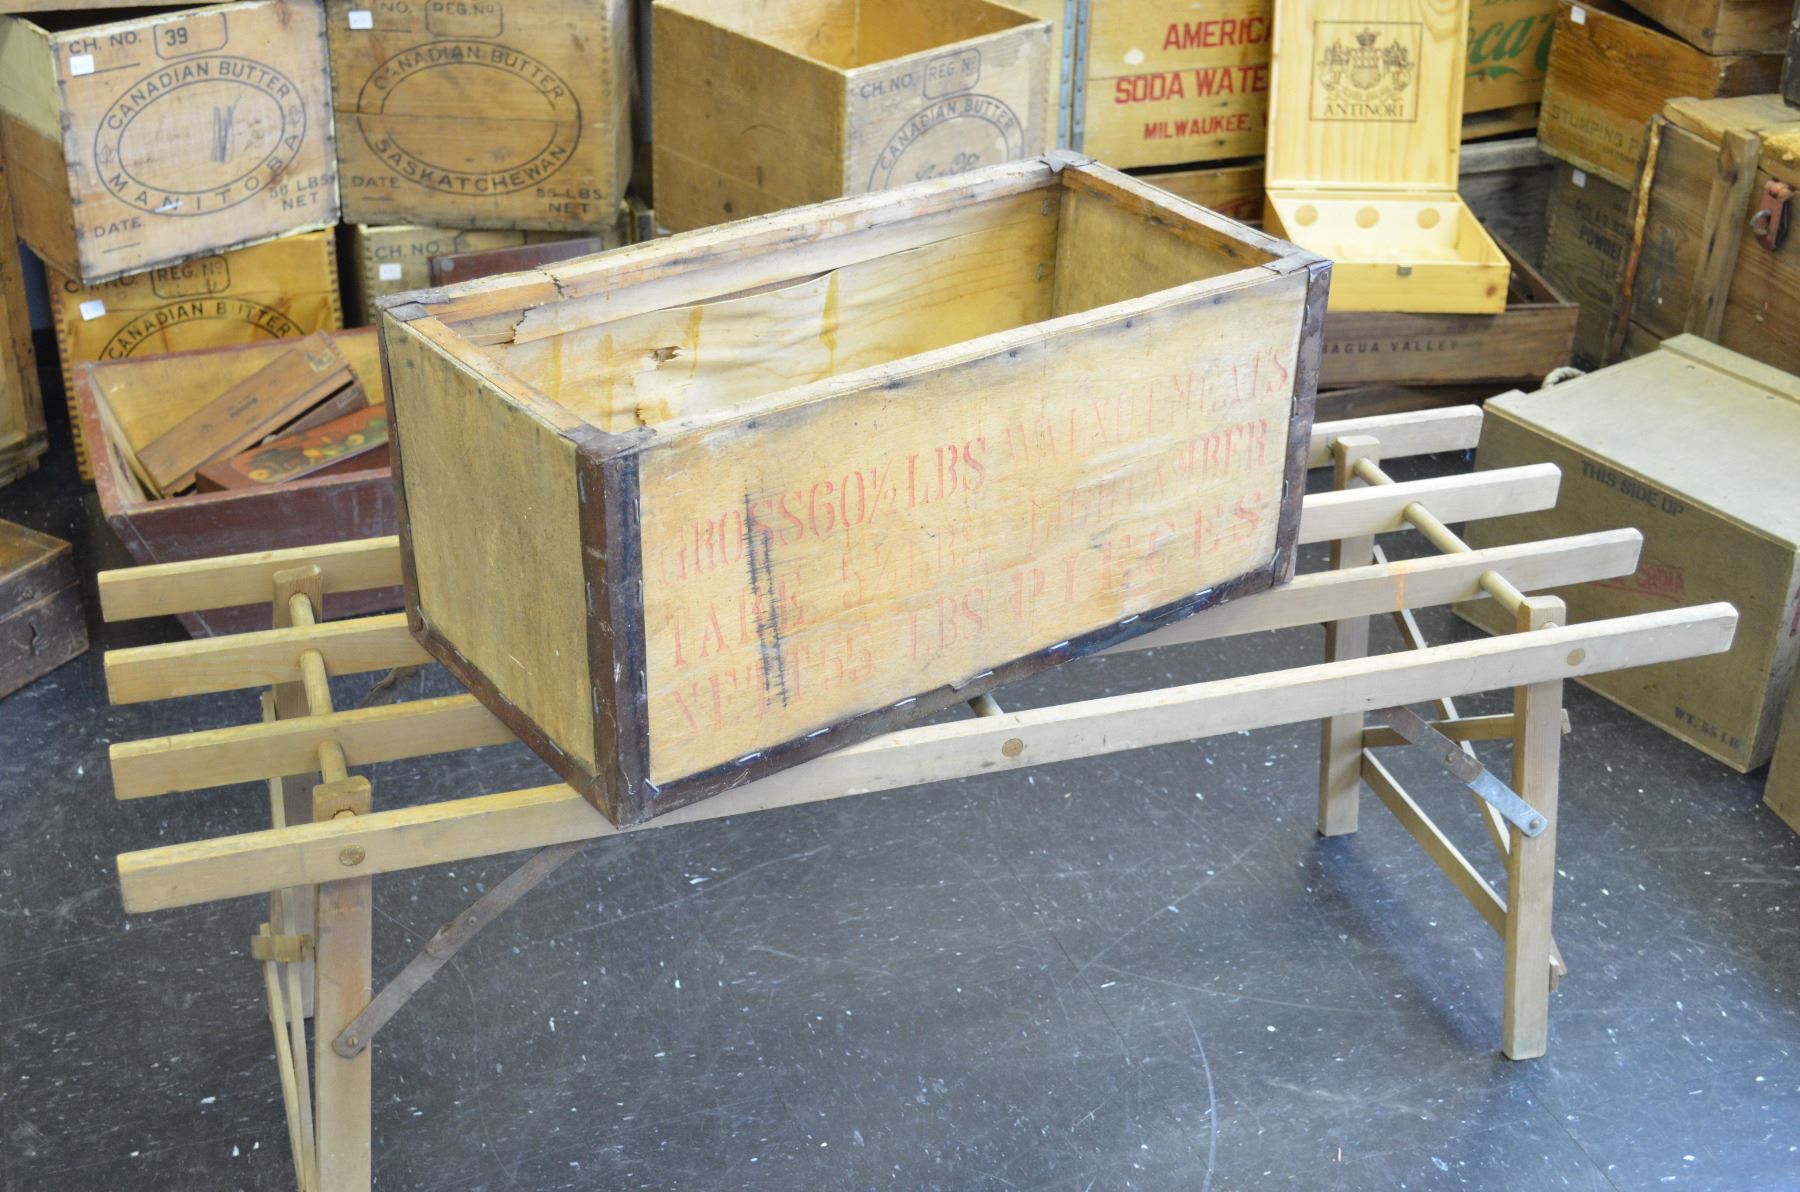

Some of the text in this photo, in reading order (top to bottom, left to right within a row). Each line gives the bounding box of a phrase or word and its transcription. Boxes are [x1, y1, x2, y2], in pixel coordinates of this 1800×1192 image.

[164, 26, 189, 47] 39
[373, 45, 565, 100] CANADIAN BUTTER
[1114, 70, 1185, 104] SODA
[107, 59, 291, 132] CANADIAN BUTTER
[1323, 102, 1405, 118] ANTINORI
[880, 102, 957, 170] CANADIAN
[964, 96, 1015, 132] BUTTER
[108, 132, 301, 212] MANITOBA
[351, 175, 401, 189] DATE
[374, 138, 568, 193] SASKATCHEWAN
[281, 191, 320, 213] NET
[93, 216, 143, 239] DATE
[98, 302, 204, 360] CANADIAN
[1391, 340, 1458, 353] VALLEY
[1581, 460, 1685, 516] THIS SIDE UP
